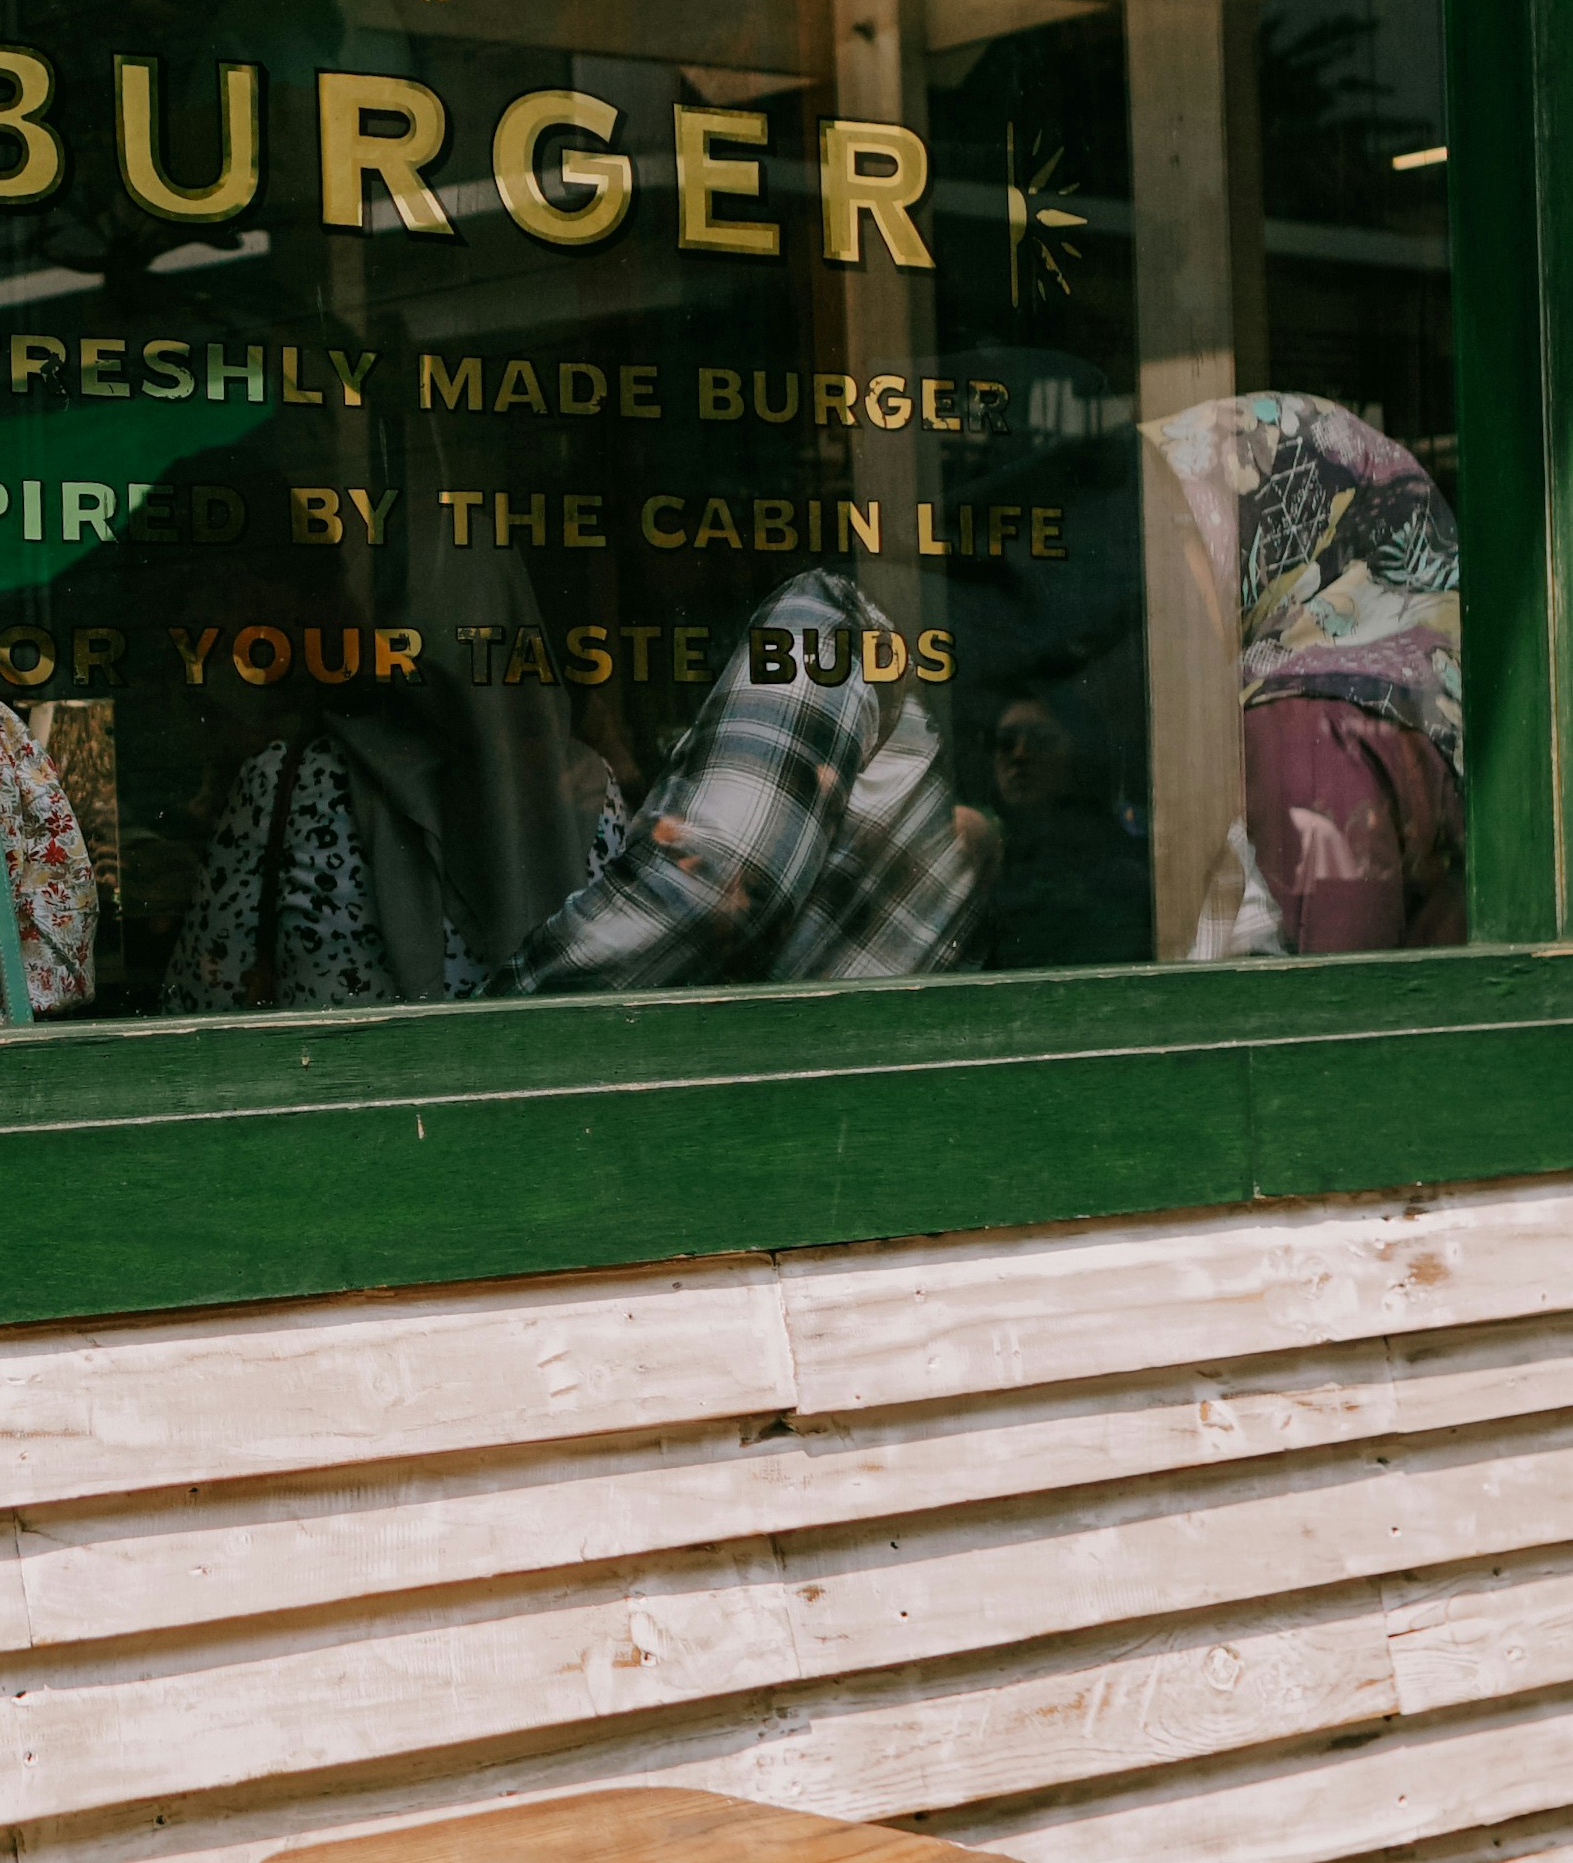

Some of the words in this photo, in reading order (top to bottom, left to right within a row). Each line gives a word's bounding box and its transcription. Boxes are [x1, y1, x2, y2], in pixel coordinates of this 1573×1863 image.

[417, 352, 664, 419] MADE
[696, 365, 1013, 435] BURGER
[288, 486, 401, 546] BY
[436, 488, 608, 550] THE
[638, 494, 883, 556] CABIN
[915, 501, 1069, 561] LIFE
[165, 625, 427, 689] YOUR
[455, 624, 717, 688] TASTE
[749, 627, 959, 689] BUDS
